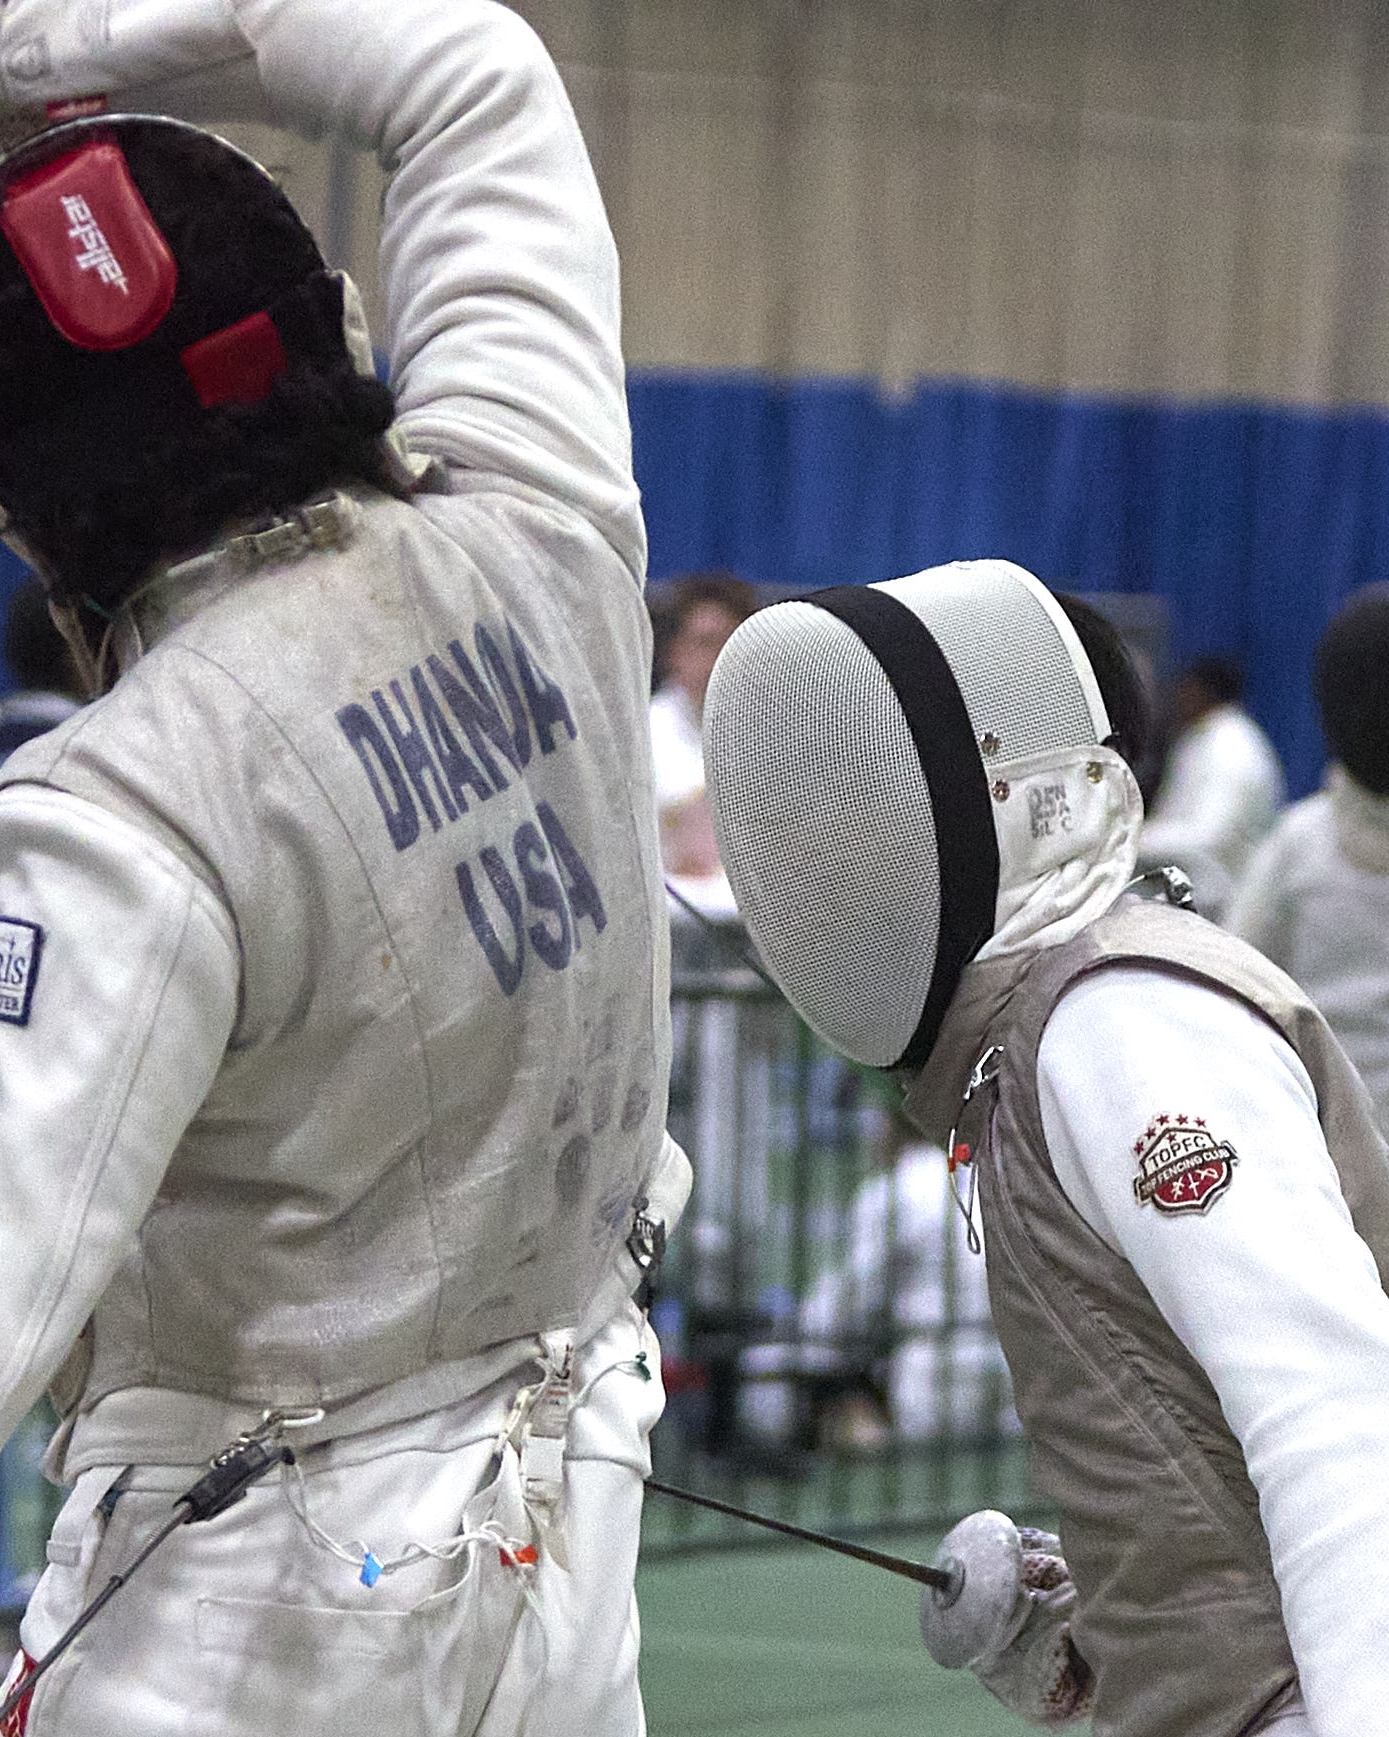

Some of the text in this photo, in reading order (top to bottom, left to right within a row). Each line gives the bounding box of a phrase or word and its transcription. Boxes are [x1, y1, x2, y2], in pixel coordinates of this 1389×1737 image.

[61, 194, 129, 294] allstar
[455, 801, 607, 997] USA
[1148, 1135, 1207, 1168] TOPFC
[1157, 1155, 1203, 1183] FENCING
[1202, 1149, 1231, 1162] CLUB
